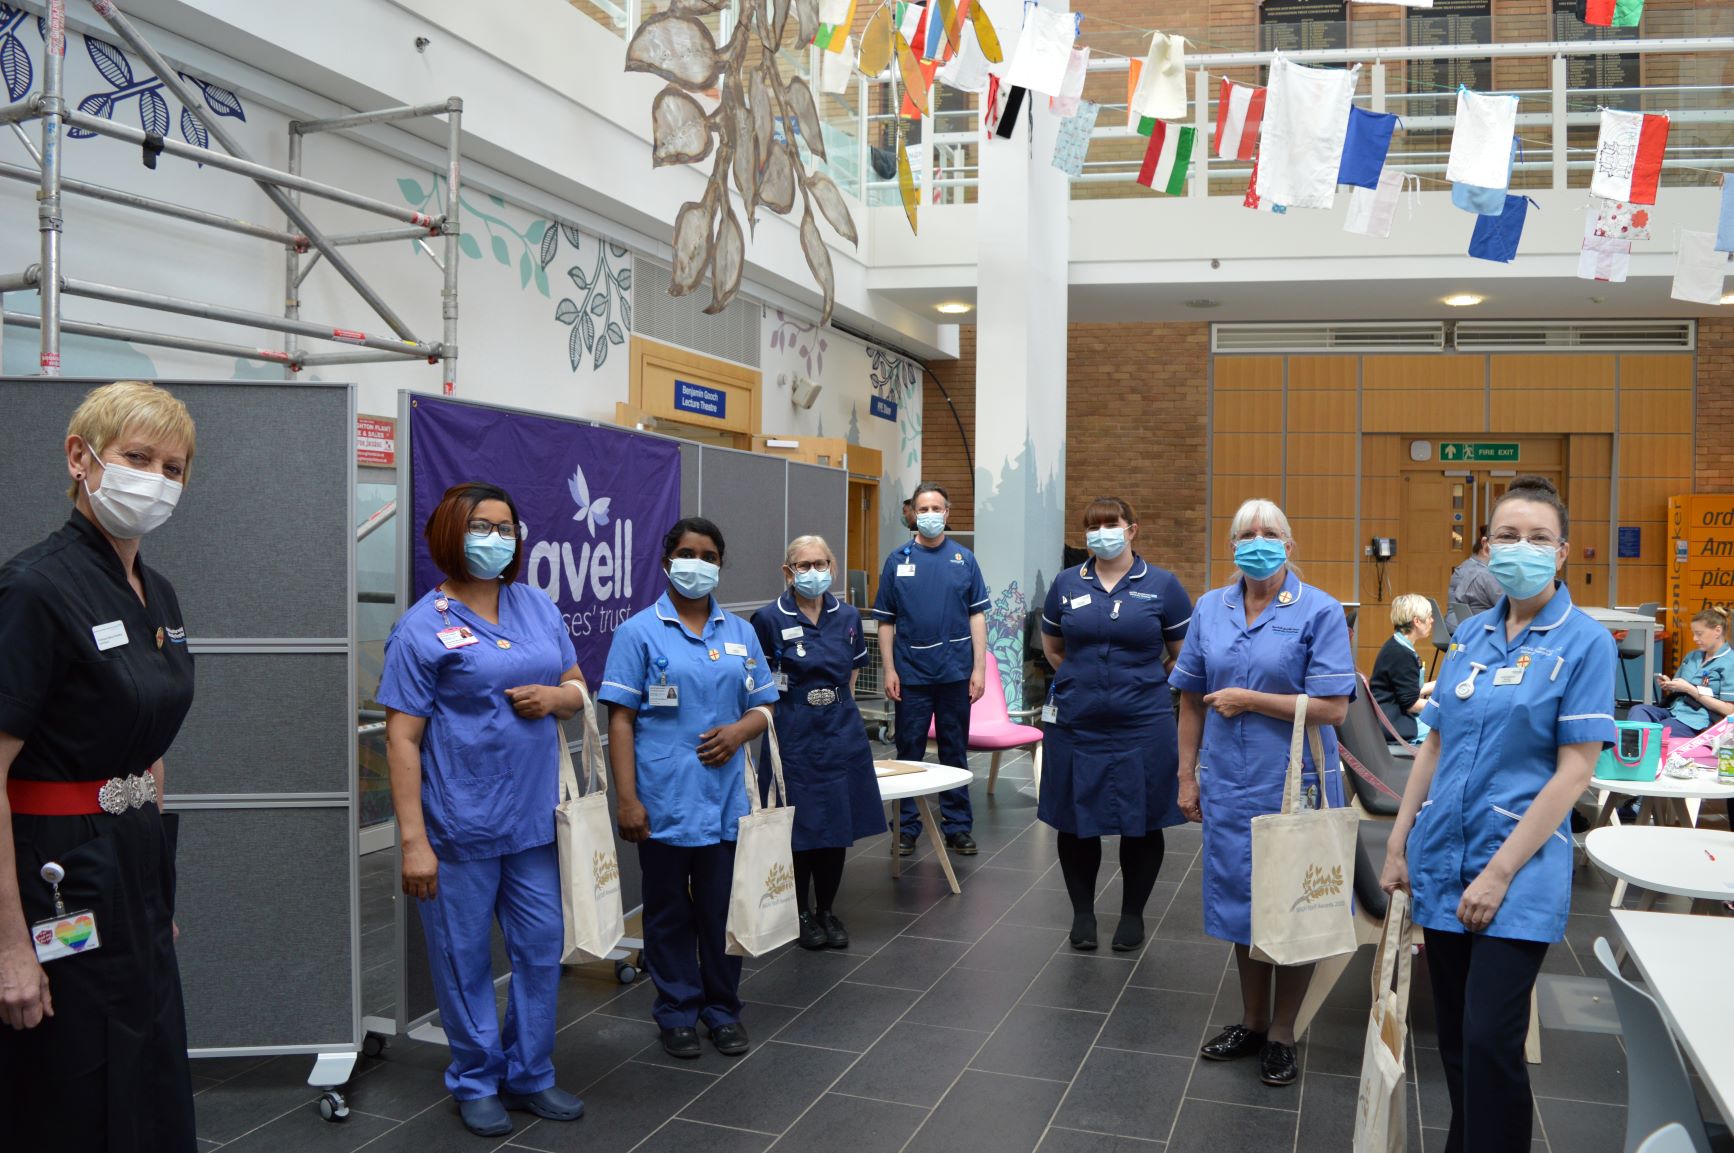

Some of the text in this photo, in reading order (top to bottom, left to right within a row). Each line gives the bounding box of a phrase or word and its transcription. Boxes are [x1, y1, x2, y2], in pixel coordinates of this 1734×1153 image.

[682, 385, 719, 402] Benjamin Gooch
[682, 397, 718, 413] Lecture Theatre
[1478, 448, 1515, 456] FIRE EXIT
[519, 518, 633, 604] avell
